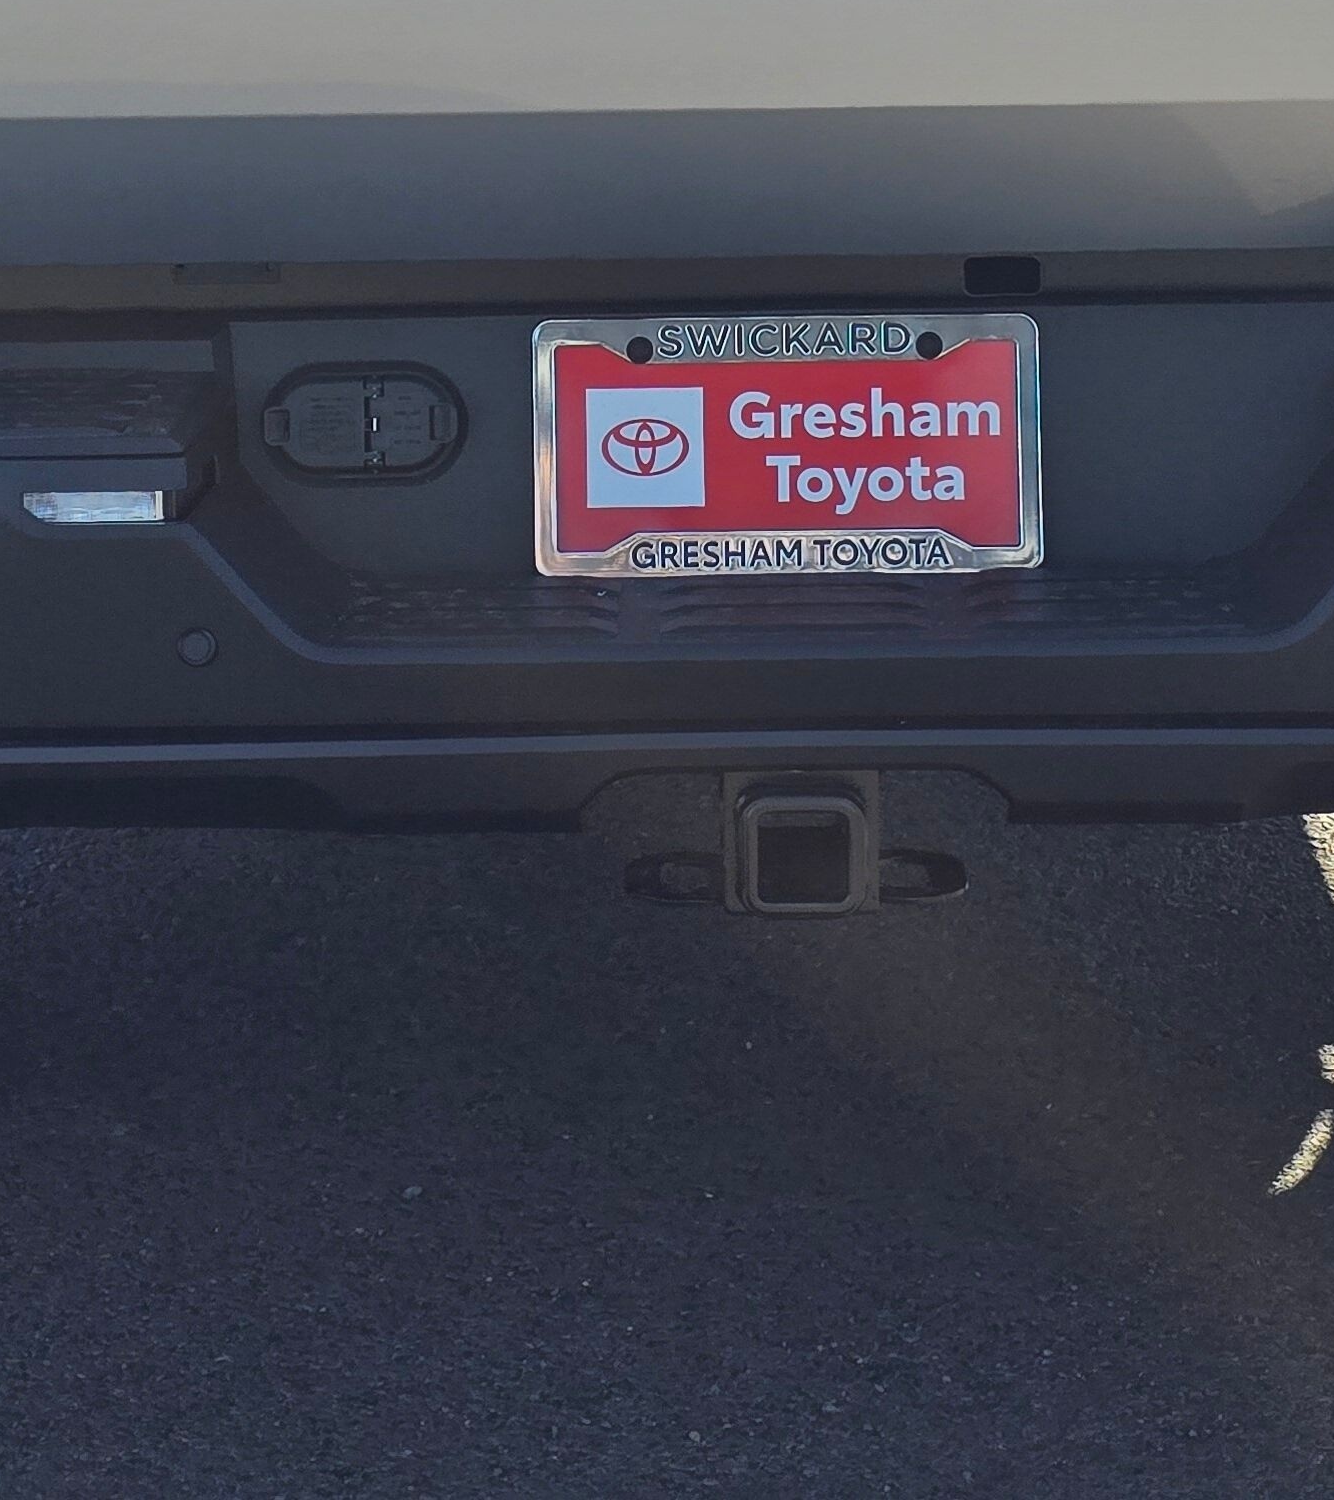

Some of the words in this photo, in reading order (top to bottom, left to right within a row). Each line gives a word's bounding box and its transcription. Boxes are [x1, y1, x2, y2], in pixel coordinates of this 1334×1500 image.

[657, 321, 911, 358] SWICKARD
[729, 387, 1001, 439] Gresham
[765, 455, 965, 515] Toyota
[630, 538, 805, 570] GRESHAM
[812, 536, 951, 569] TOYOTA
